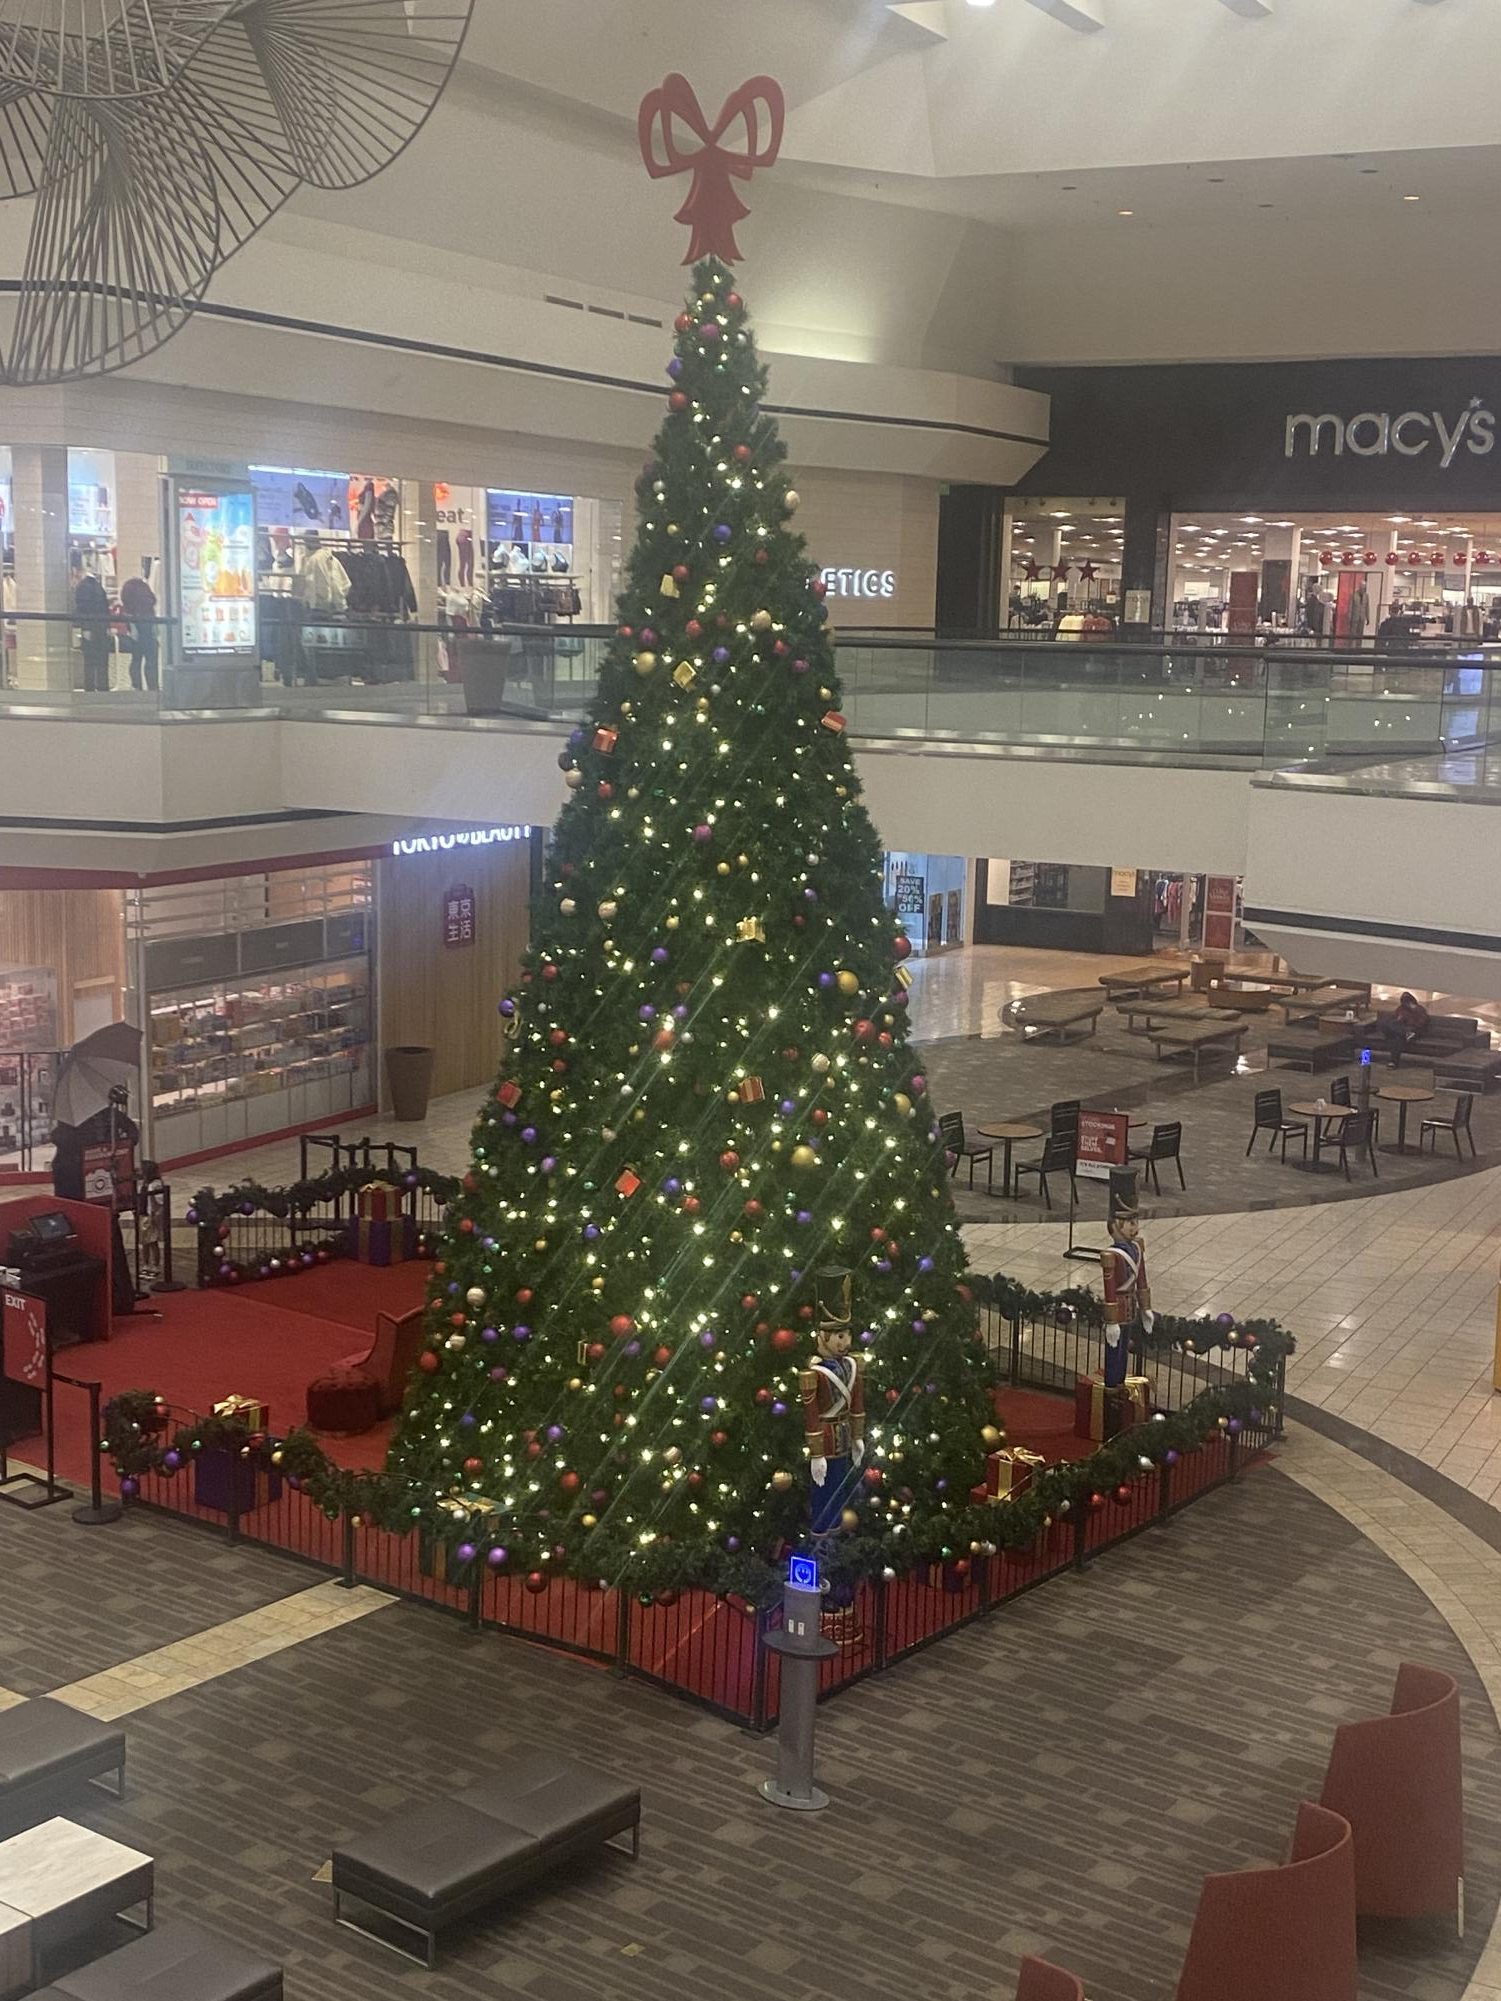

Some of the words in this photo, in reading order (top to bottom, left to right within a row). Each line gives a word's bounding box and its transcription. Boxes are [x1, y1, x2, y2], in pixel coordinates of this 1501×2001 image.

[897, 885, 921, 895] 20%
[898, 904, 921, 913] OFF
[5, 1294, 26, 1311] EXIT
